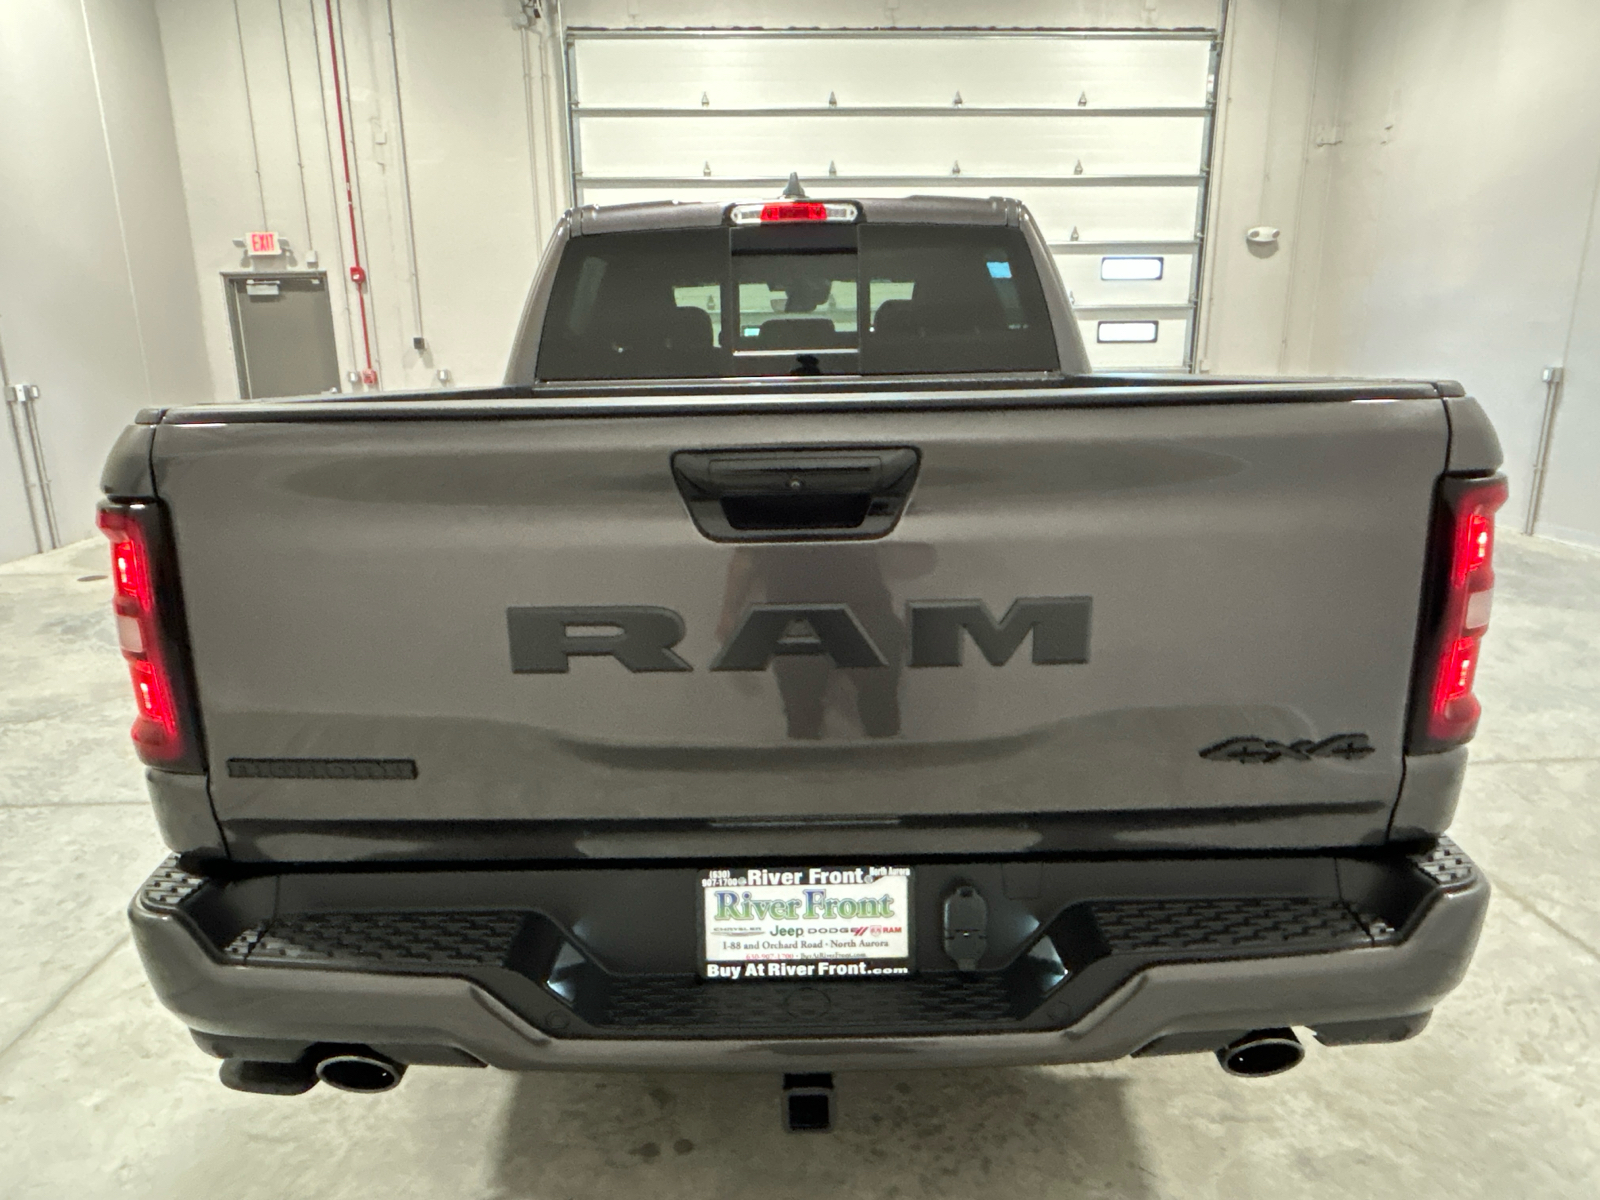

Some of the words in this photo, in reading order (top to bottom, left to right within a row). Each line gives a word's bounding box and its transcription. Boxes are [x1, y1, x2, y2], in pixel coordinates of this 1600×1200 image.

[251, 233, 275, 252] EXIT
[507, 597, 1093, 673] RAM
[709, 870, 731, 879] (630)
[747, 869, 803, 886] River
[809, 868, 864, 885] Front
[702, 878, 738, 888] 907-1700
[769, 925, 805, 938] Jeep
[882, 926, 903, 934] RAM
[743, 940, 760, 950] and
[762, 940, 799, 950] Orchard
[801, 940, 824, 949] Road
[830, 939, 857, 949] North
[859, 939, 890, 948] Aurora
[707, 963, 742, 980] Buy
[744, 962, 766, 977] At
[767, 962, 816, 977] River
[817, 961, 909, 976] Front.com
